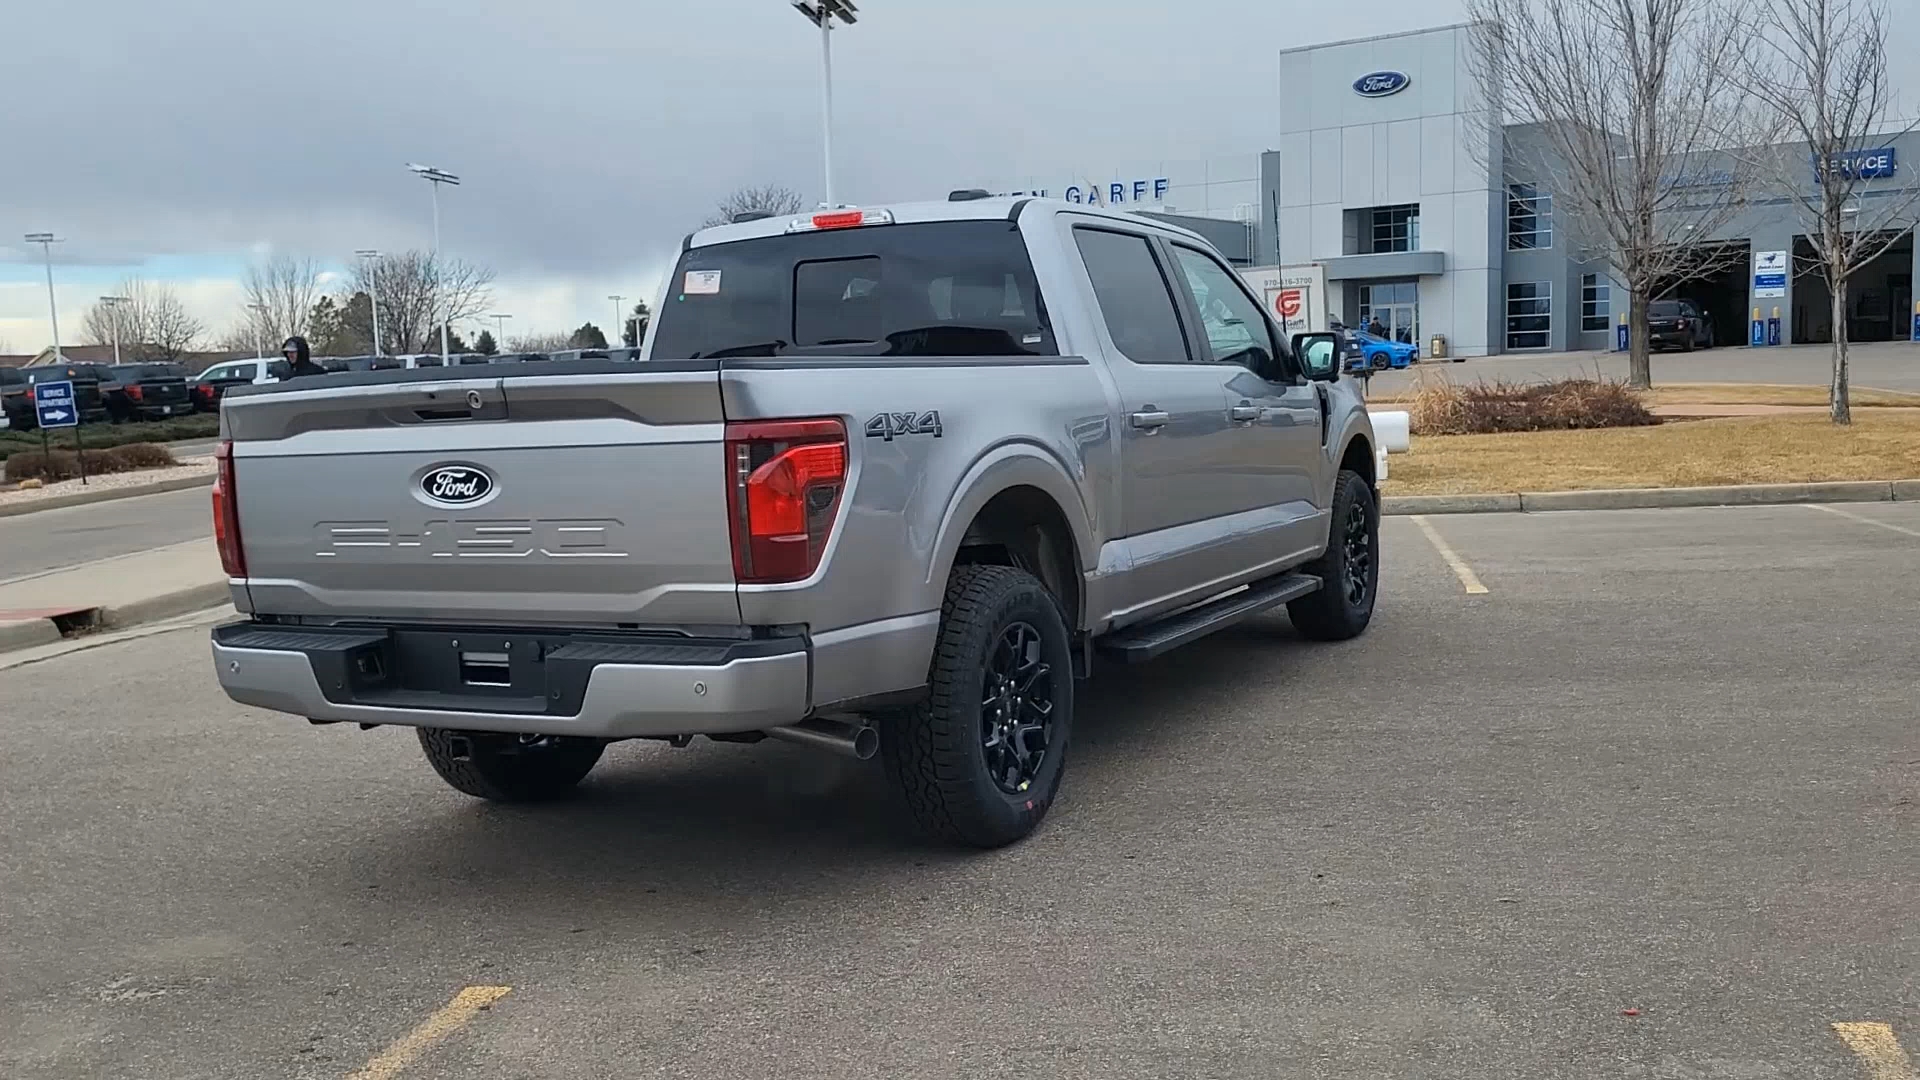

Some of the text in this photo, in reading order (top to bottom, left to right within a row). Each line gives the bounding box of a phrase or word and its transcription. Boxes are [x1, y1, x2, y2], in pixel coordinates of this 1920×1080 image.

[1065, 178, 1169, 205] GARFF
[432, 471, 478, 497] Ford
[313, 518, 629, 557] F-150
